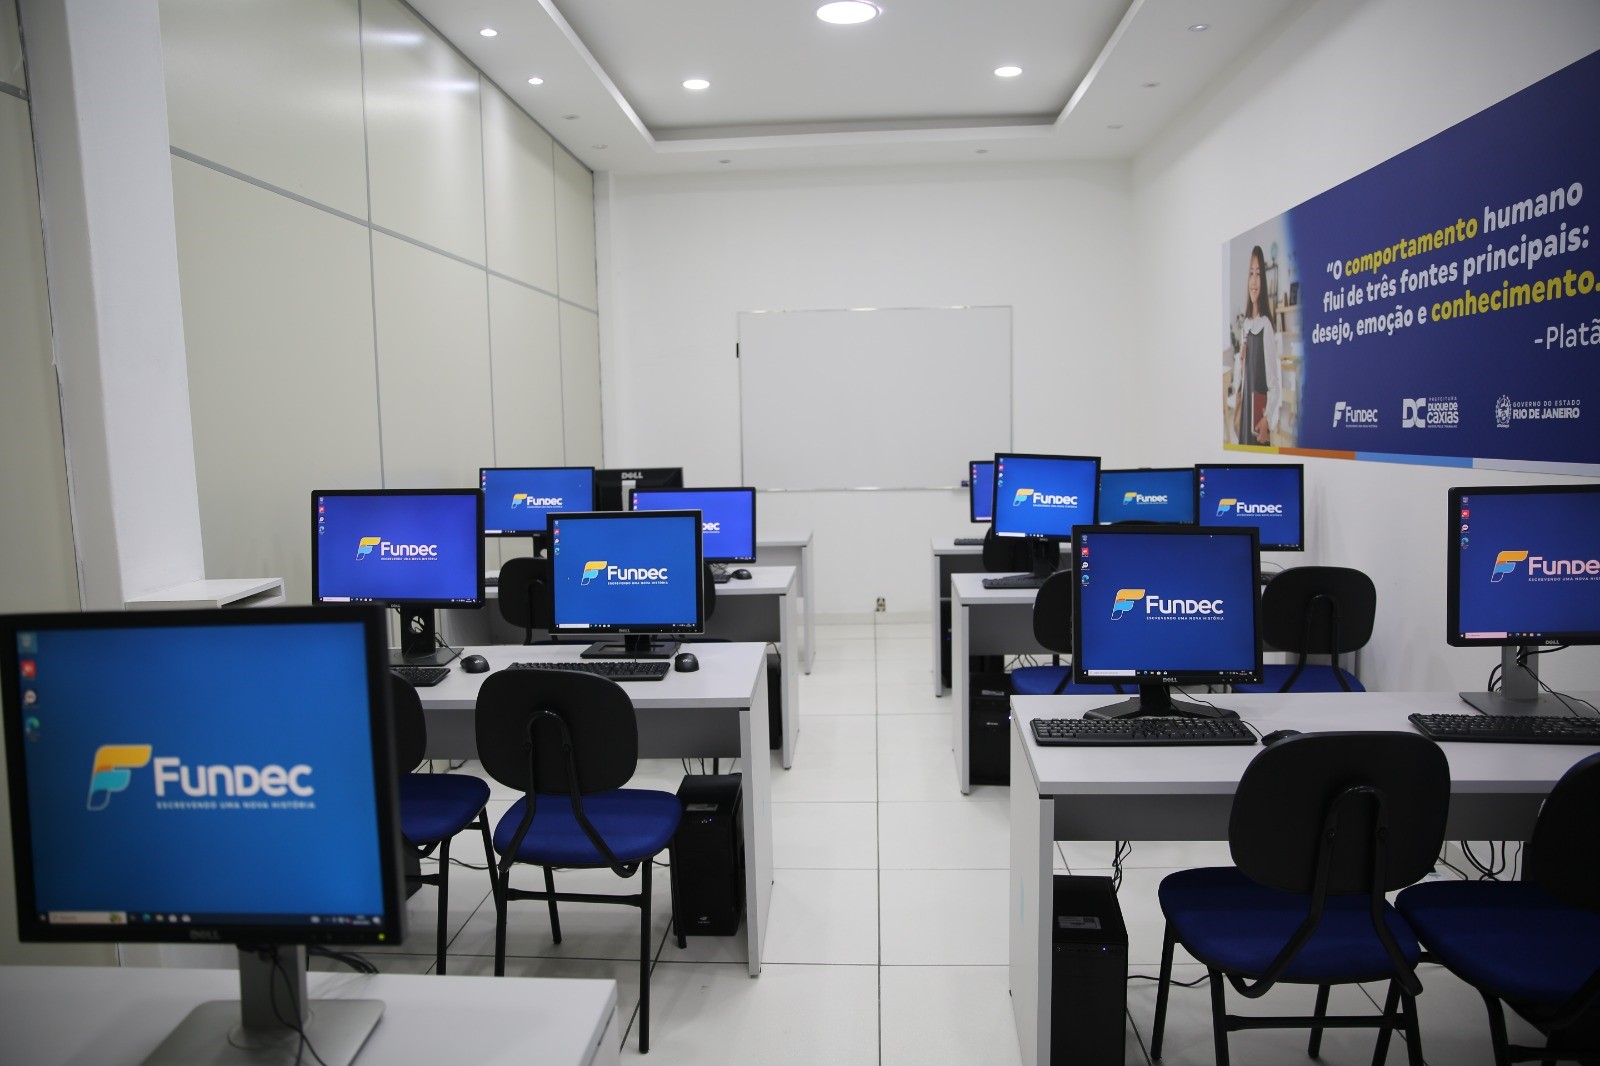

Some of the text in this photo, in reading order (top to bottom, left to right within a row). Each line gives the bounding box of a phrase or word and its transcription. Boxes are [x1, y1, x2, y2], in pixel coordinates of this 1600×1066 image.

[1345, 218, 1478, 276] comportamento
[1483, 182, 1583, 234] humano
[1323, 222, 1590, 313] flui de três fontes principais:
[1312, 269, 1600, 345] desejo, emoção e conhecimento.
[1534, 318, 1600, 350] -Platã
[1512, 407, 1580, 419] RIO DE JANEIRO
[219, 801, 241, 810] UMA
[242, 801, 269, 810] NOVA
